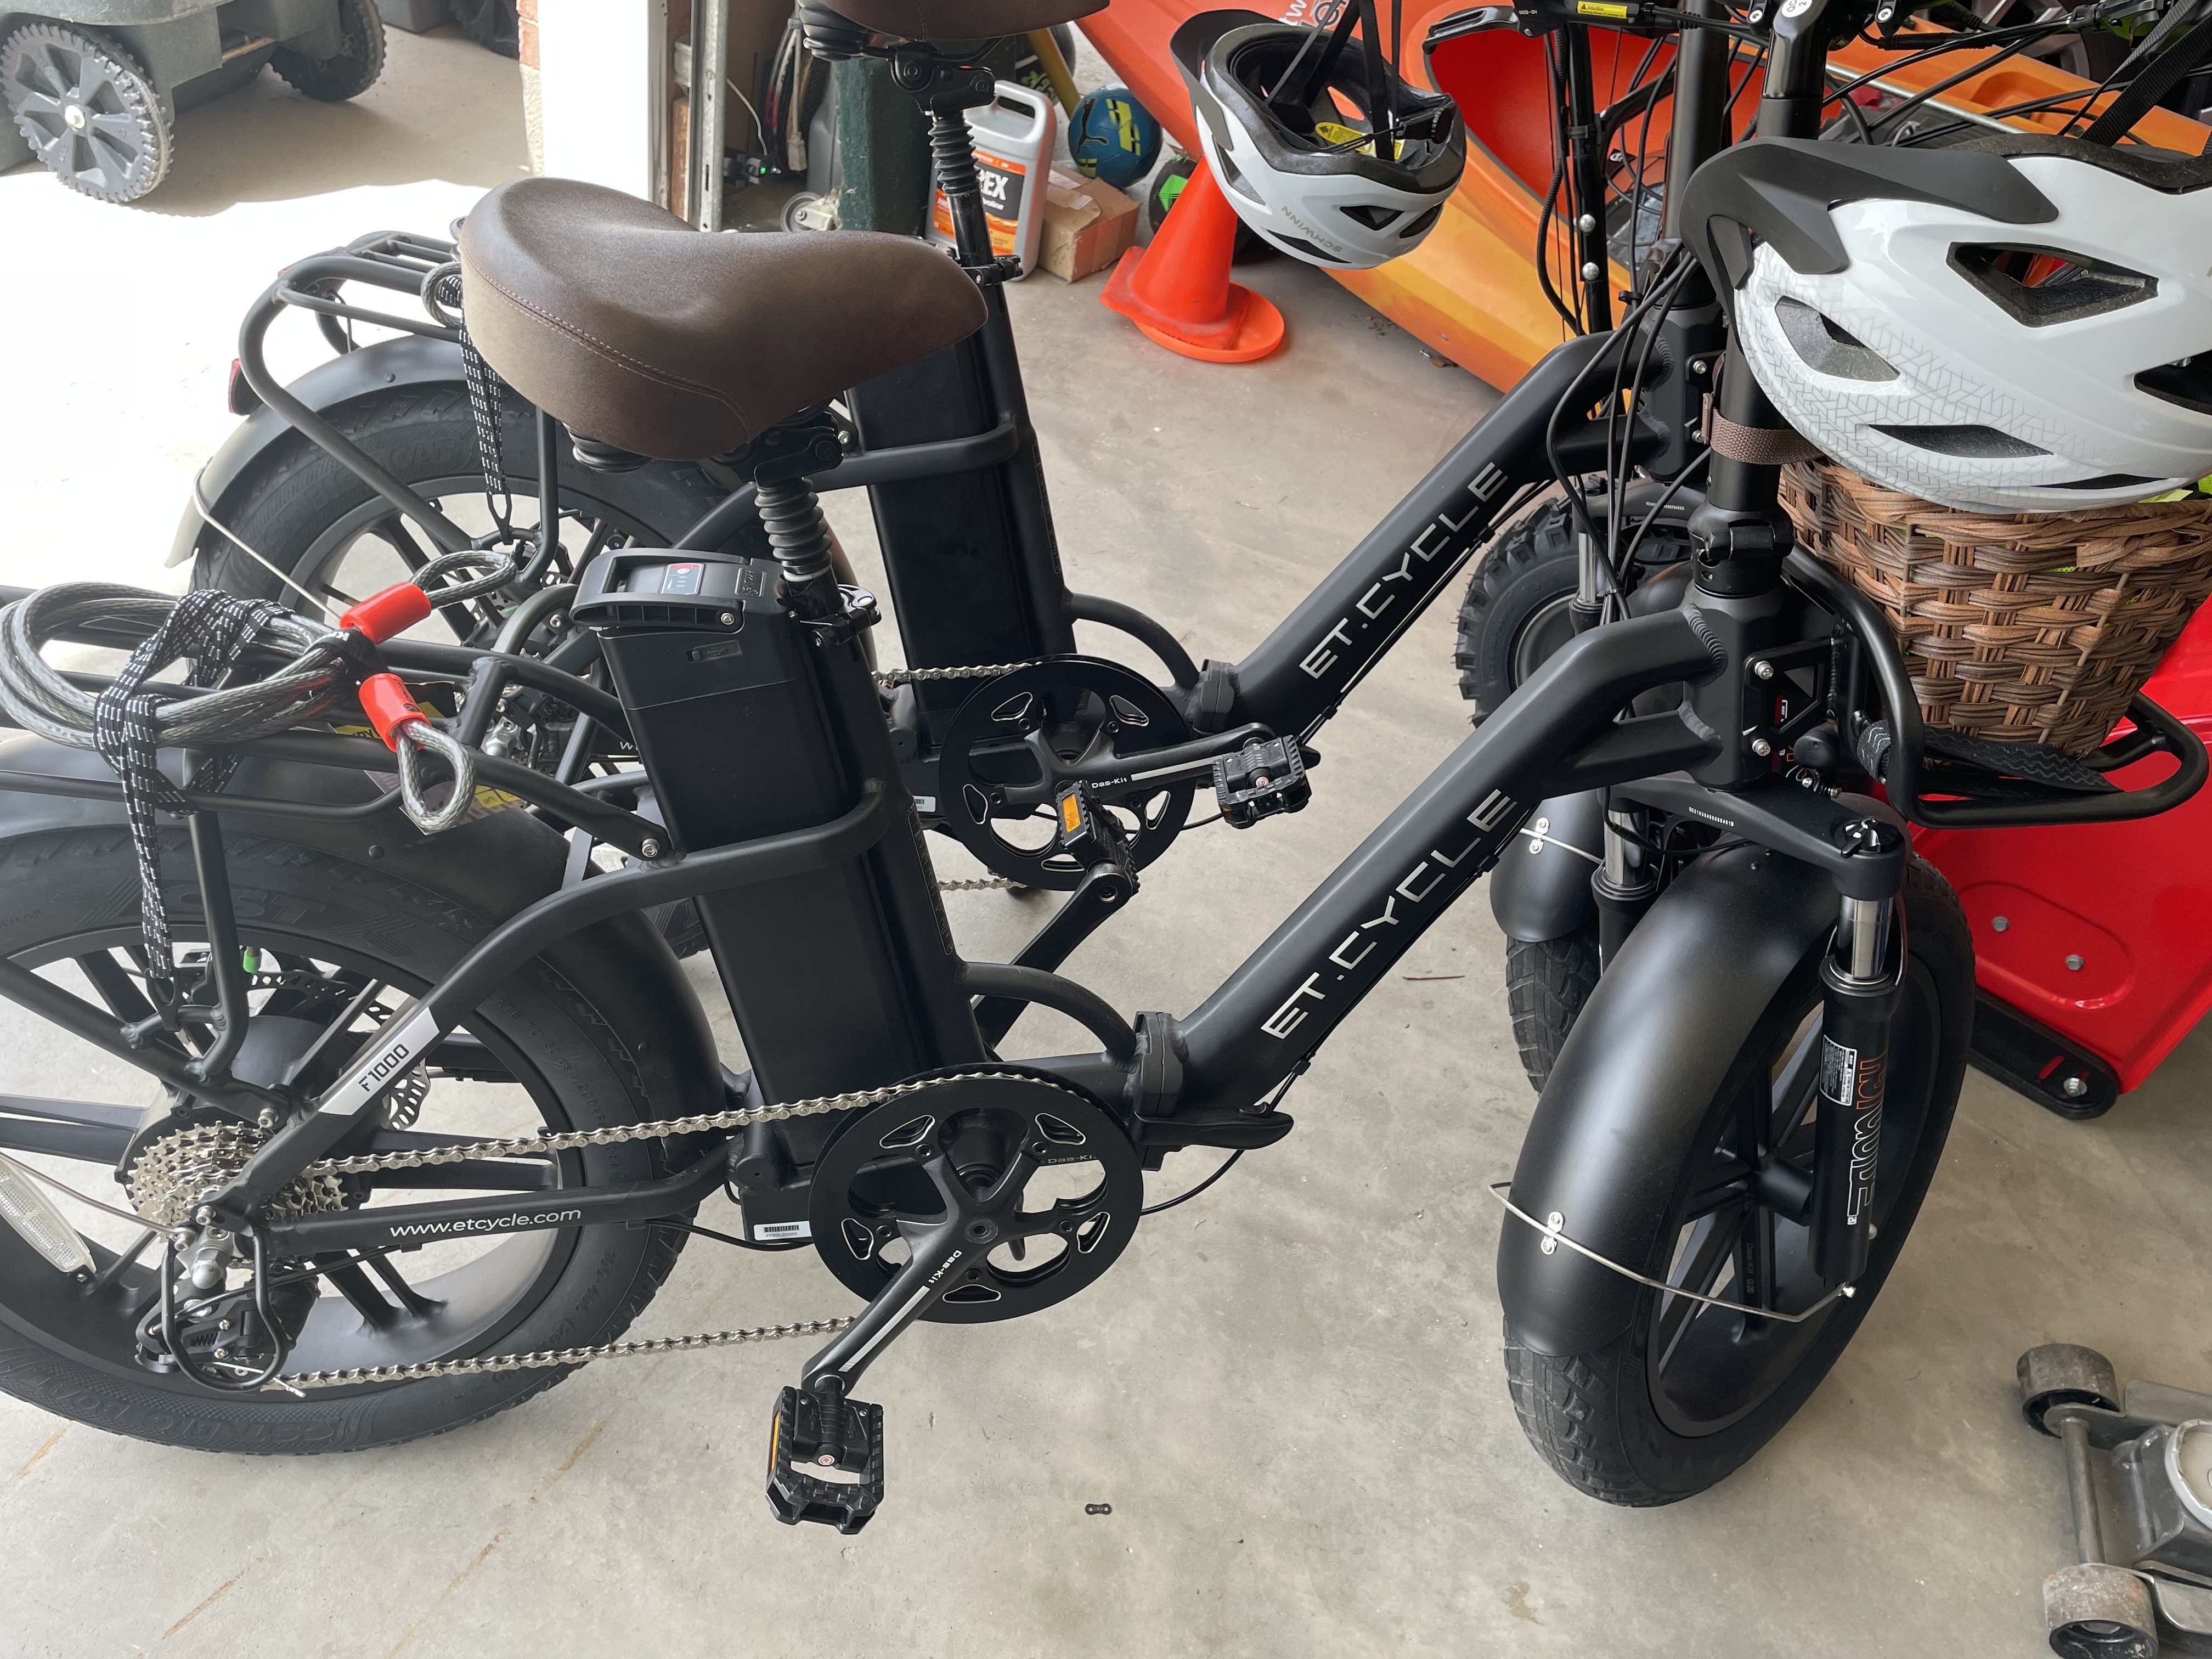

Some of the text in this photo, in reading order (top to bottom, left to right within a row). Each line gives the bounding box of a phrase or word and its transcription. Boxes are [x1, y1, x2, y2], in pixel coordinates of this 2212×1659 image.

[1281, 205, 1344, 252] SCHWINN
[1299, 462, 1509, 680] ET.CYCLE
[1091, 777, 1128, 789] Das-Kit
[1261, 788, 1517, 1040] ET.CYCLE
[358, 1043, 409, 1092] F1000
[390, 1209, 582, 1237] www.etcycle.com
[928, 1249, 963, 1284] Das-Kit
